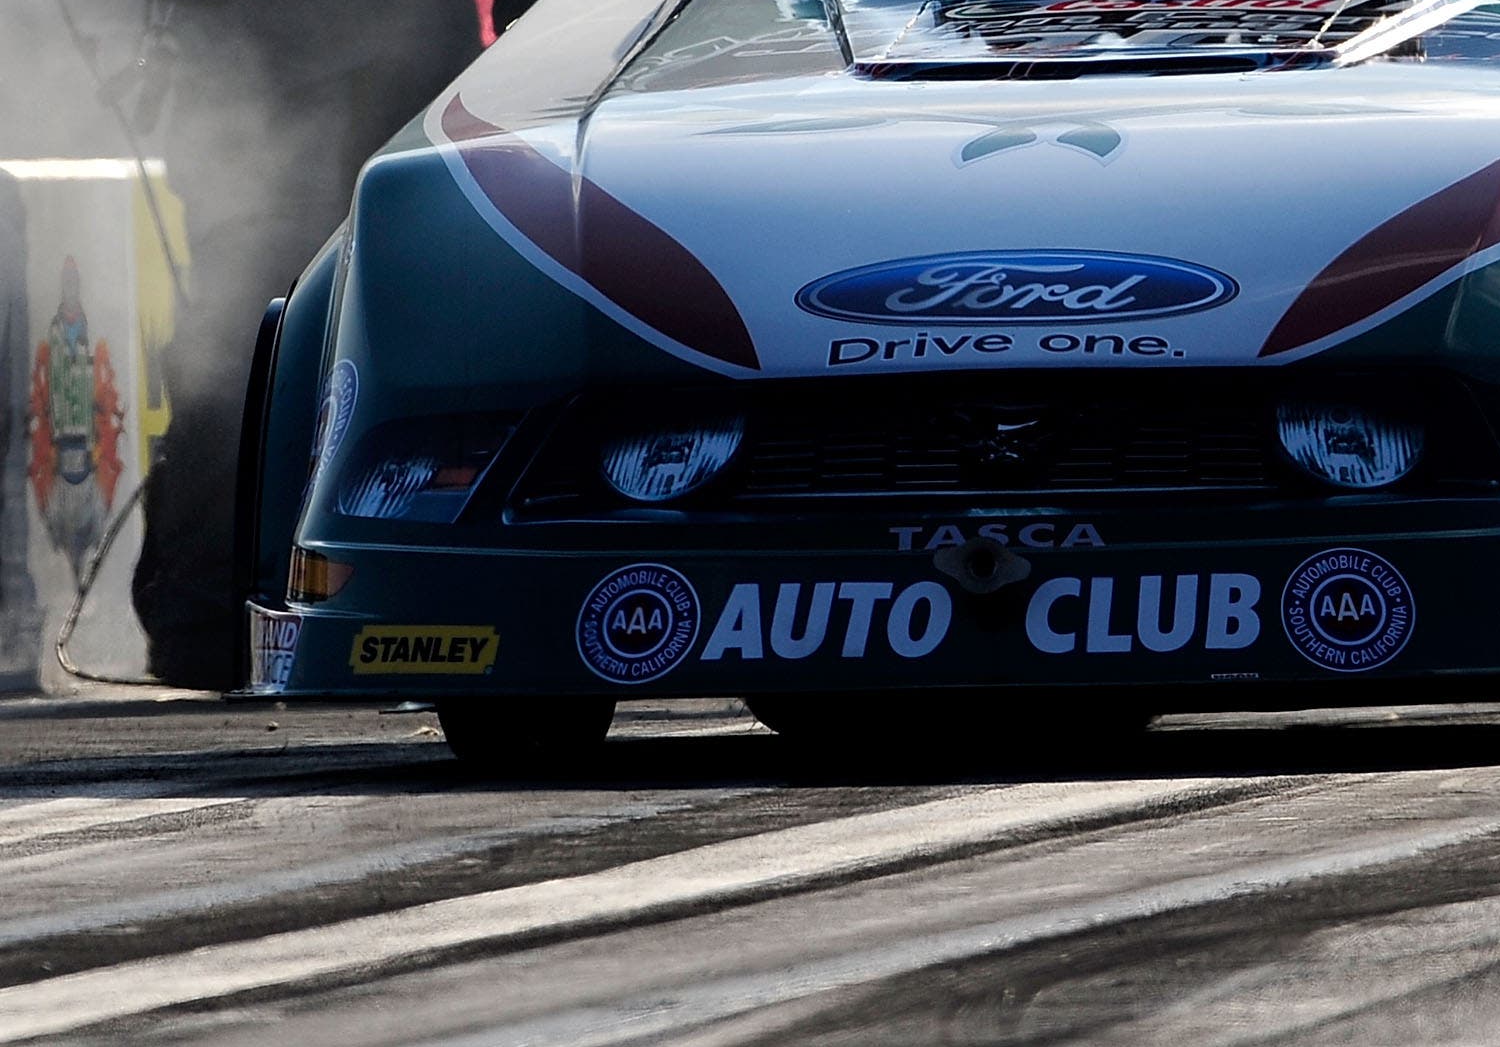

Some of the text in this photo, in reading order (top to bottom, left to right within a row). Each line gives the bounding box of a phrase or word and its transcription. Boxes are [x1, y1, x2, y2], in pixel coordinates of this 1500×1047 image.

[884, 262, 1148, 313] Ford
[826, 331, 1187, 368] Drive one.
[889, 523, 1106, 551] TASCA
[590, 570, 691, 613] AUTOMOBILE CLUB
[1292, 554, 1402, 599] AUTOMOBILE CLUB
[611, 606, 663, 635] AAA
[700, 572, 1262, 661] AUTO CLUB
[1320, 592, 1376, 622] AAA
[359, 636, 489, 664] STANLEY
[584, 619, 692, 677] SOUTHERN CALIFORNIA
[1288, 605, 1408, 665] SOUTHERN CALIFORNIA
